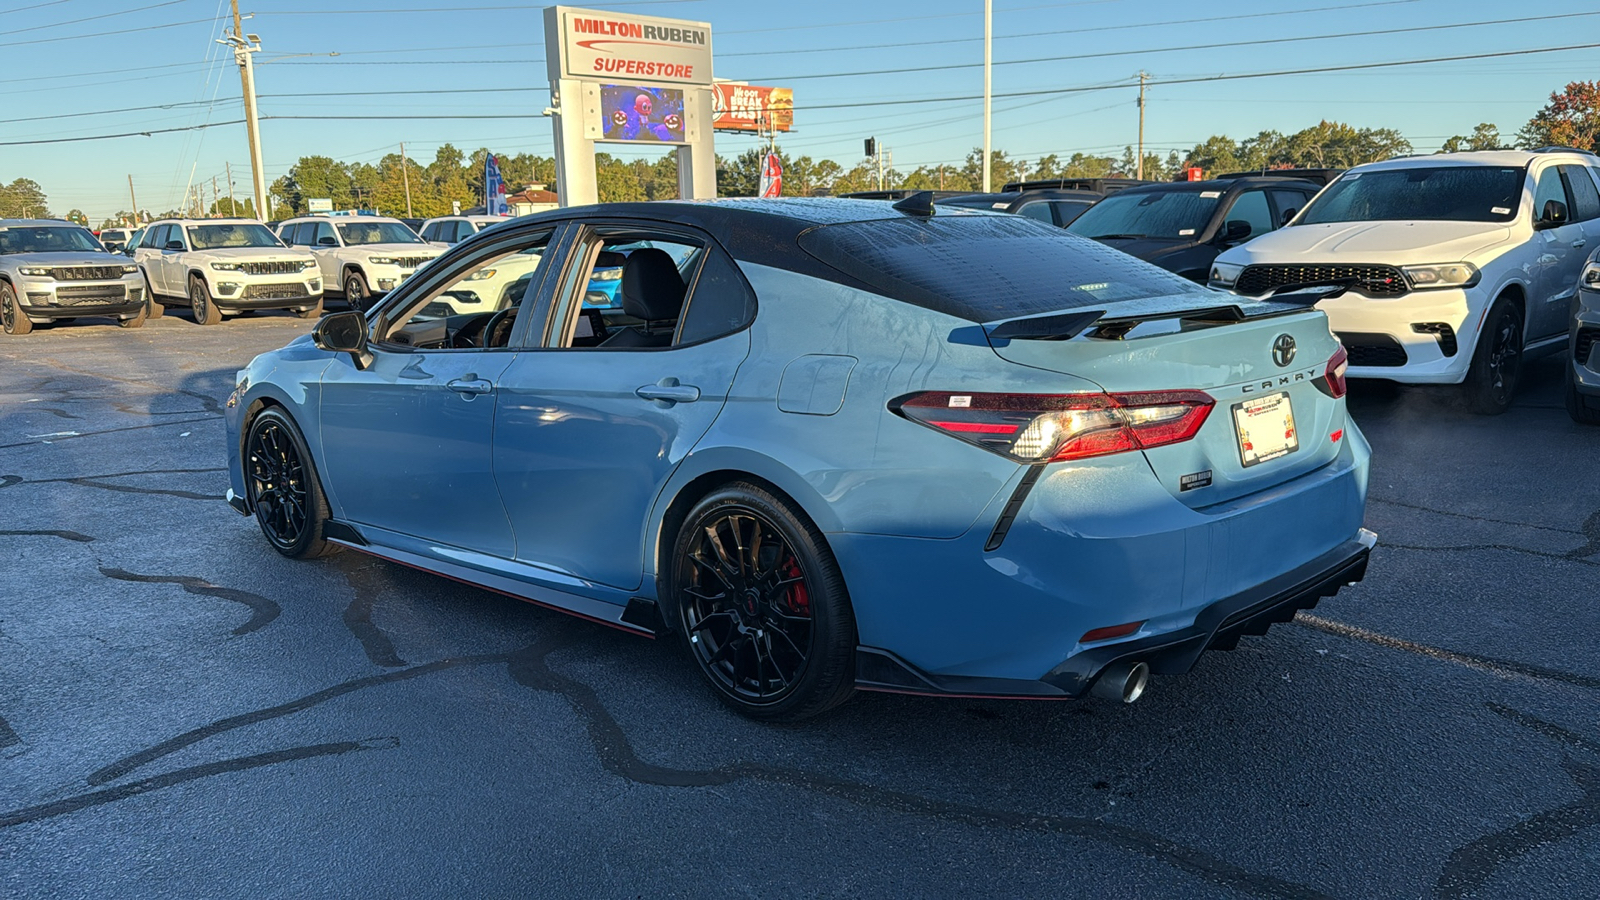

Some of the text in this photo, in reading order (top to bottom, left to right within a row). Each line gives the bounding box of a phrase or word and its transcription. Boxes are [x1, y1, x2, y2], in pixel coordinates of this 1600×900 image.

[574, 18, 705, 45] MILTON RUBEN
[593, 57, 693, 78] SUPERSTORE
[730, 95, 763, 109] BREAK
[730, 105, 763, 120] FAST
[1241, 369, 1315, 393] CAMRY
